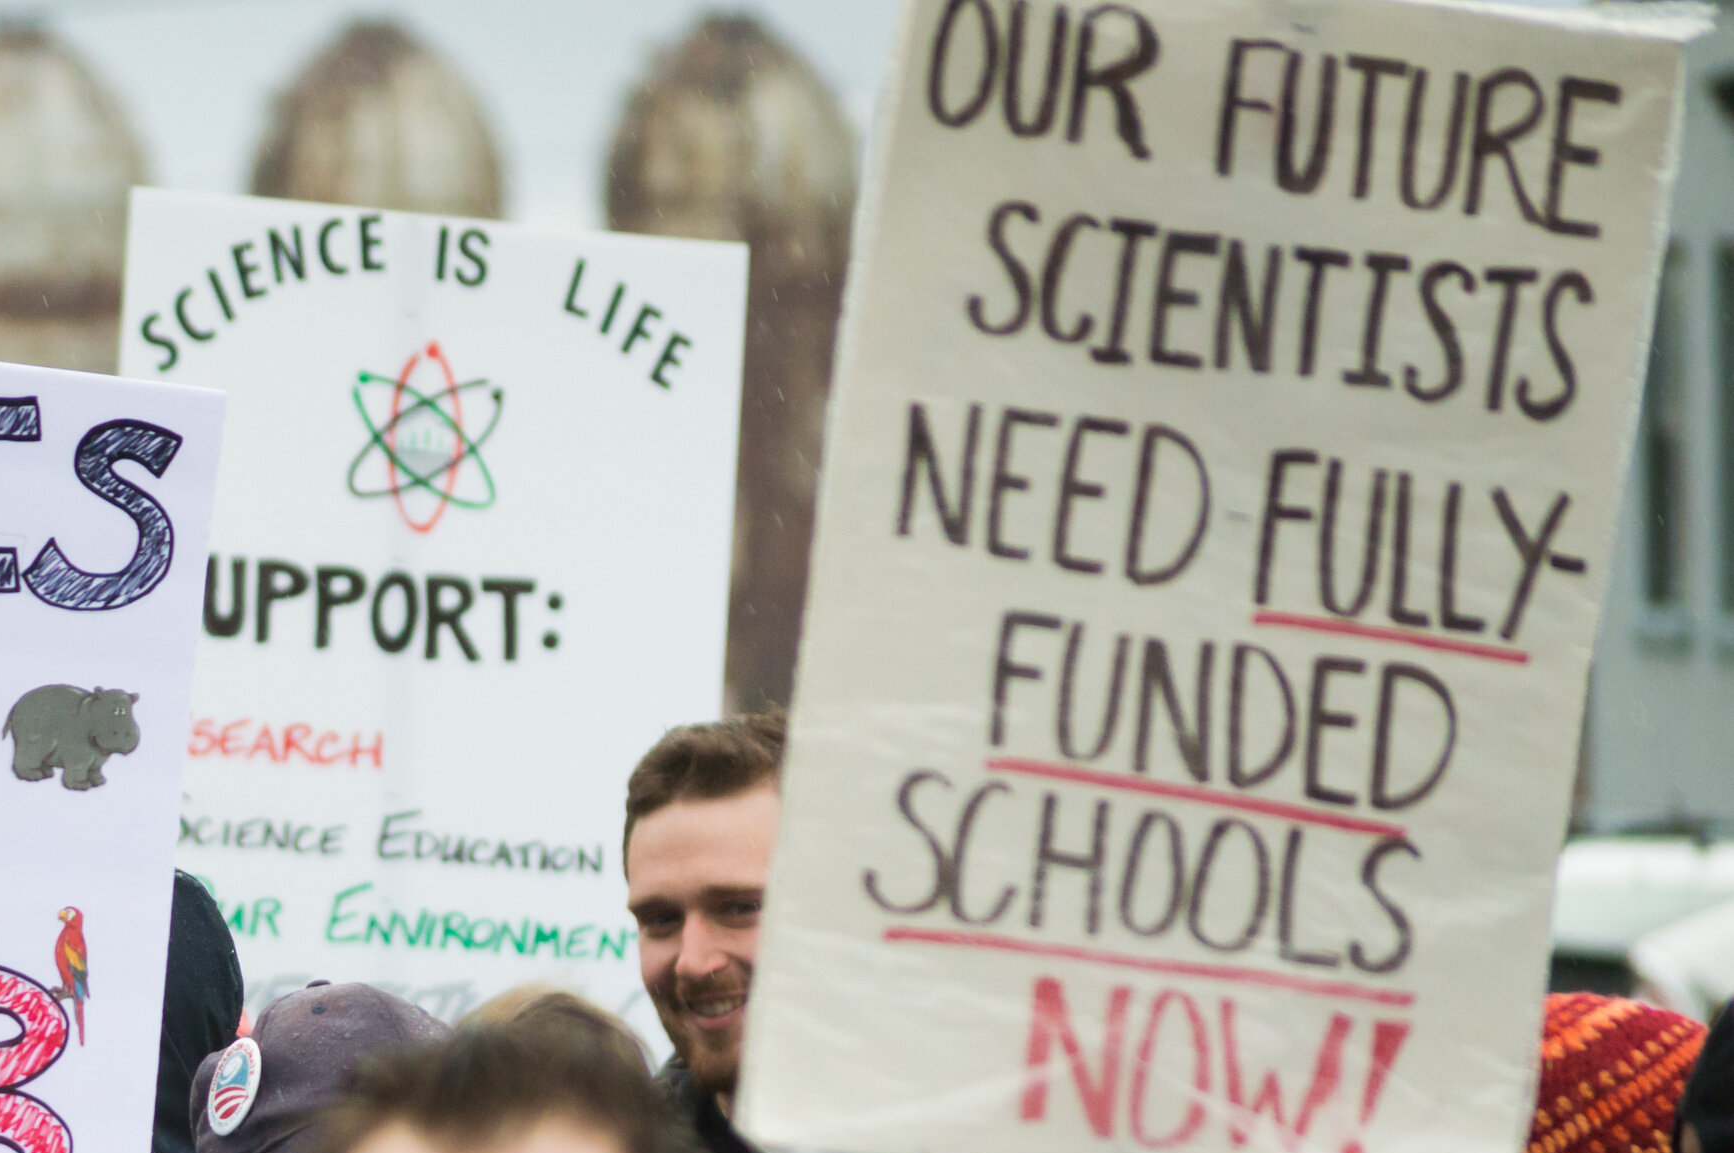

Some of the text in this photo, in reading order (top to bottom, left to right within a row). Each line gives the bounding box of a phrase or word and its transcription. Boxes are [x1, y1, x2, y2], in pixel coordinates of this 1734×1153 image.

[927, 0, 1624, 239] OUR FUTURE
[141, 214, 693, 390] SCIENCE IS LIFE
[966, 201, 1596, 421] SCIENTISTS
[203, 553, 564, 662] UPPORT:
[896, 402, 1588, 642] NEED FULLY-
[187, 714, 384, 770] SEARCH
[987, 610, 1460, 811] FUNDED
[194, 874, 638, 960] UR ENVIRONMEN
[376, 808, 604, 875] EDUCATION
[864, 770, 1423, 973] SCHOOLS
